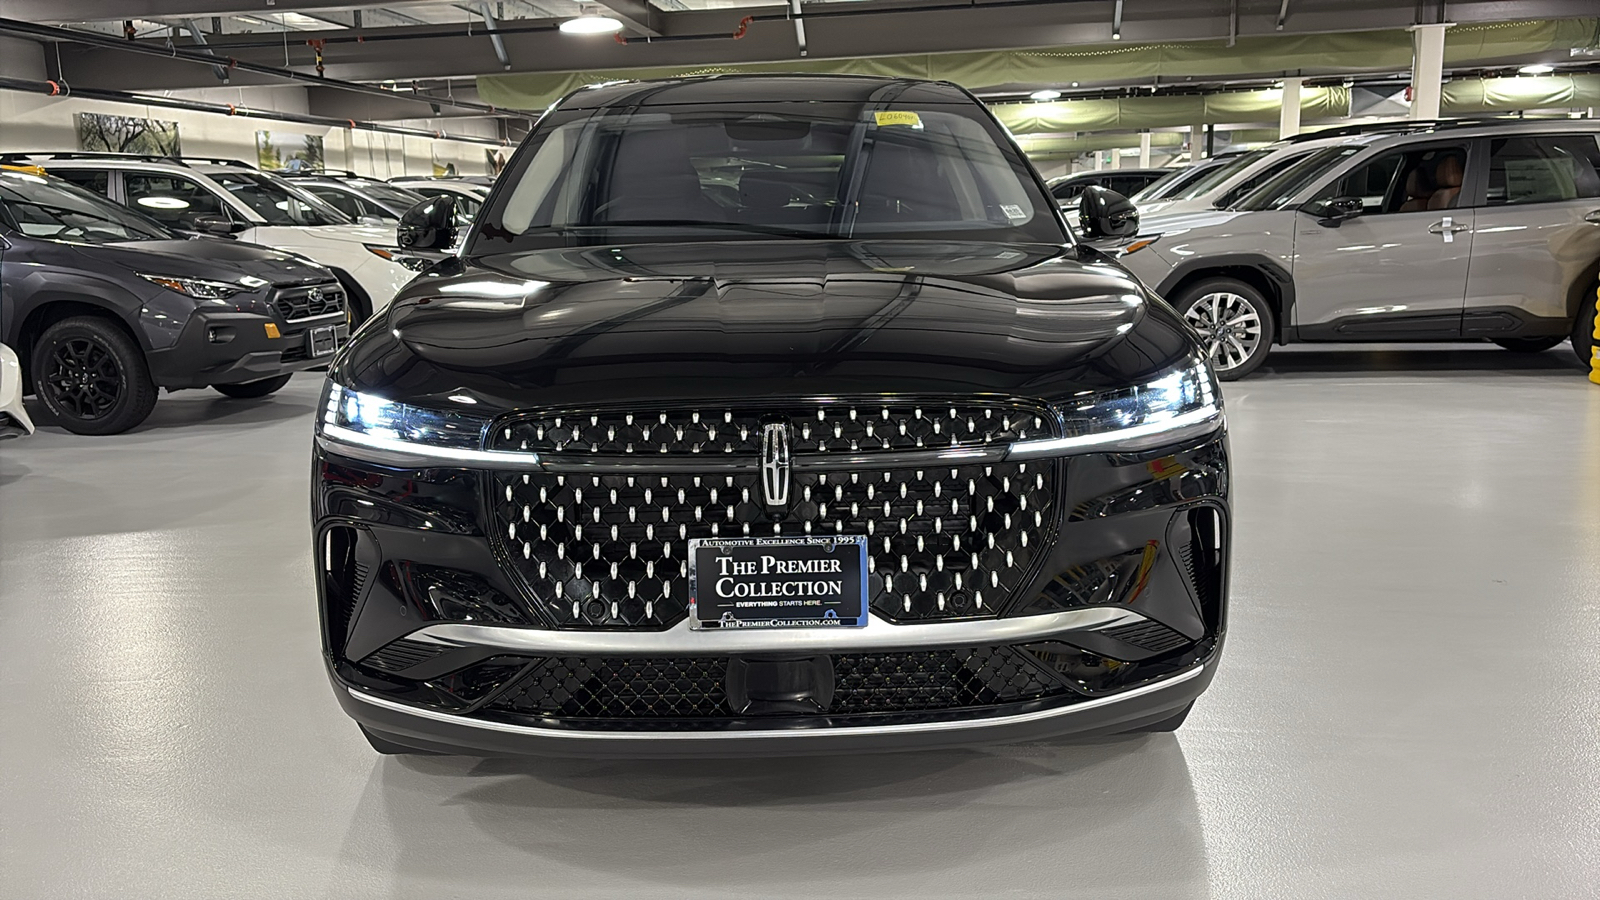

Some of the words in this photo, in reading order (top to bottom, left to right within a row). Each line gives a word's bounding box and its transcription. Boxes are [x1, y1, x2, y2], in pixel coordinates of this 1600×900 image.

[702, 539, 754, 547] AUTOMOTIVE
[833, 536, 855, 544] 1995
[715, 556, 758, 576] THE
[760, 555, 842, 575] PREMIER
[715, 577, 842, 598] COLLECTION
